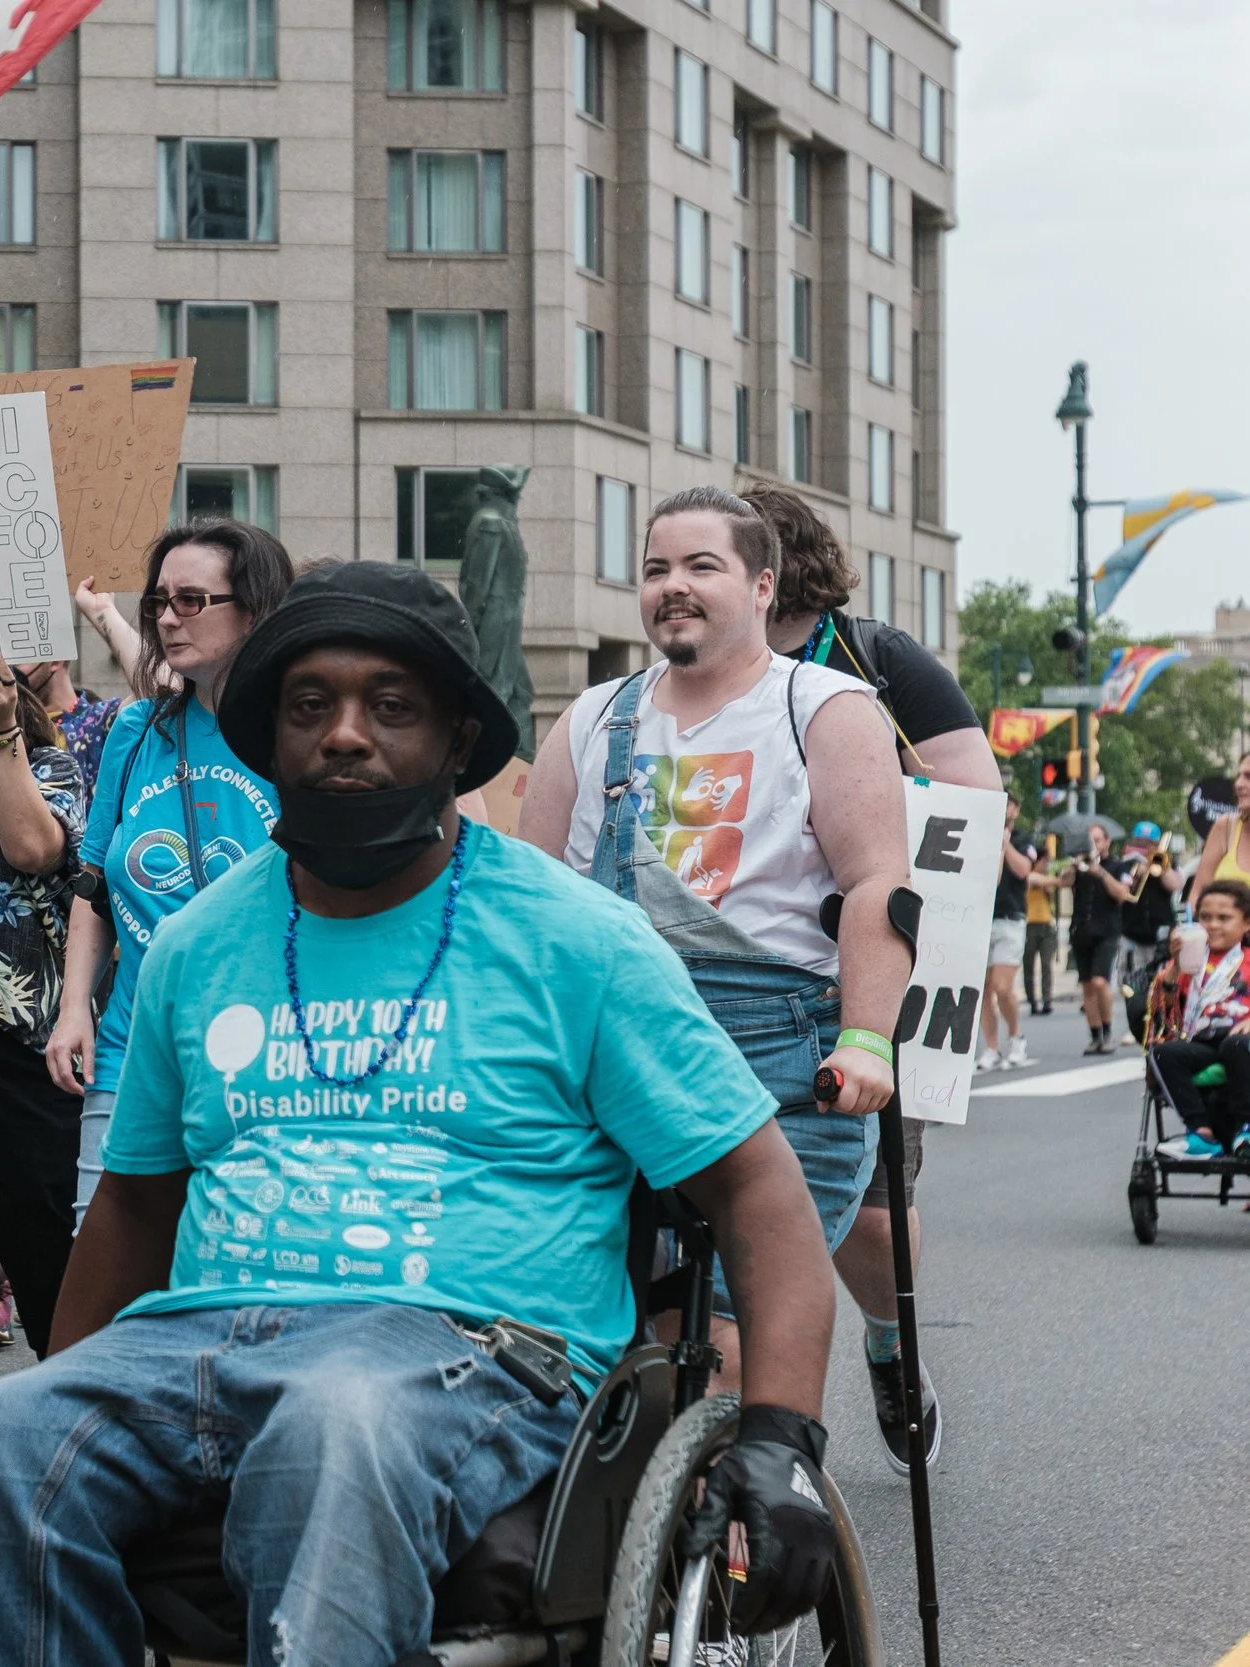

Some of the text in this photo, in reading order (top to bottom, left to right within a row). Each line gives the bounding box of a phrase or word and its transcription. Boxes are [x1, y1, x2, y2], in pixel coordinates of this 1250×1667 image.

[112, 892, 152, 947] SUPPO
[924, 894, 975, 923] eer
[270, 998, 448, 1037] HAPPY 10TH
[266, 1035, 437, 1083] BIRTHDAY!
[228, 1084, 468, 1120] Disability Pride
